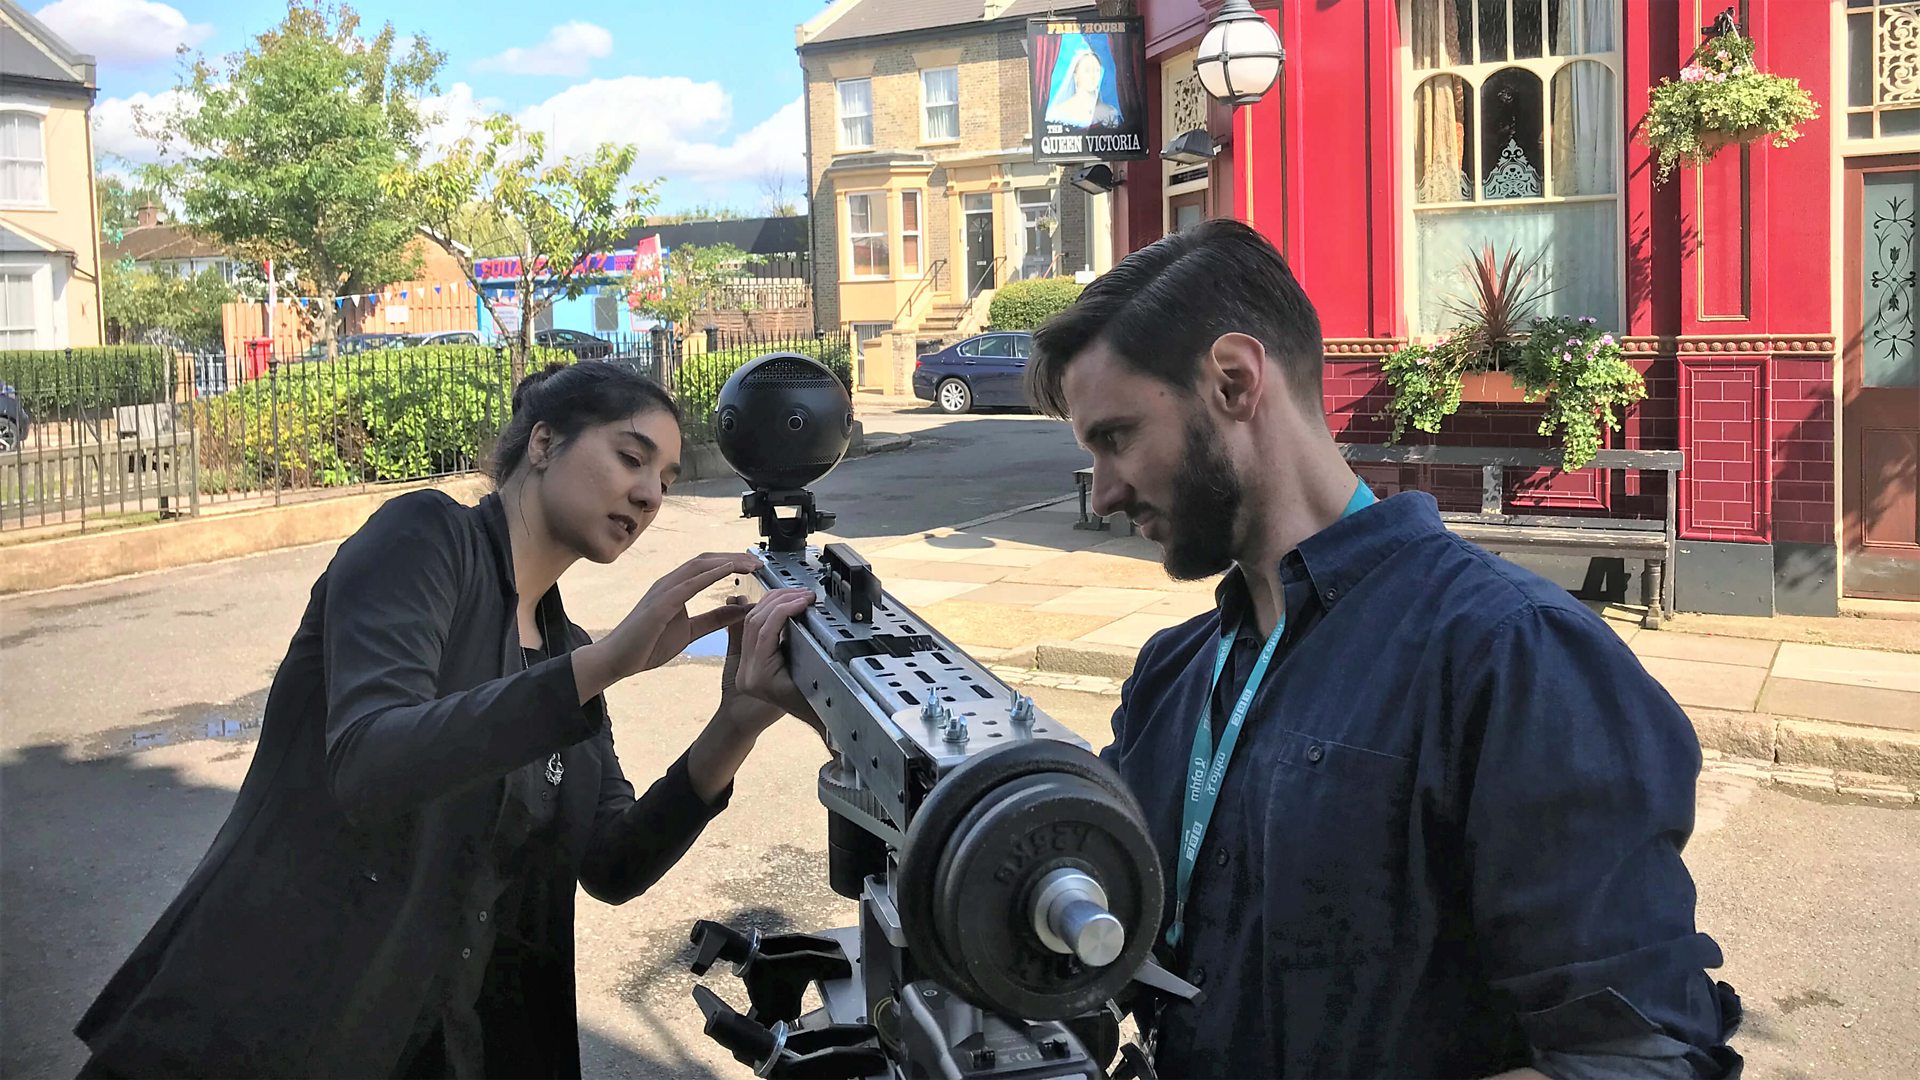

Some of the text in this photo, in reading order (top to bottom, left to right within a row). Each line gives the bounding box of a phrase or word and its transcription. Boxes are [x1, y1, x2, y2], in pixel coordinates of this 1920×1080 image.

[1047, 21, 1126, 34] FREE HOUSE
[1047, 125, 1064, 134] THE
[1041, 134, 1141, 154] QUEEN VICTORIA
[481, 256, 548, 279] SQUAE
[1211, 752, 1226, 783] mhfa
[1190, 770, 1204, 802] mhfa
[1185, 821, 1203, 861] BBC
